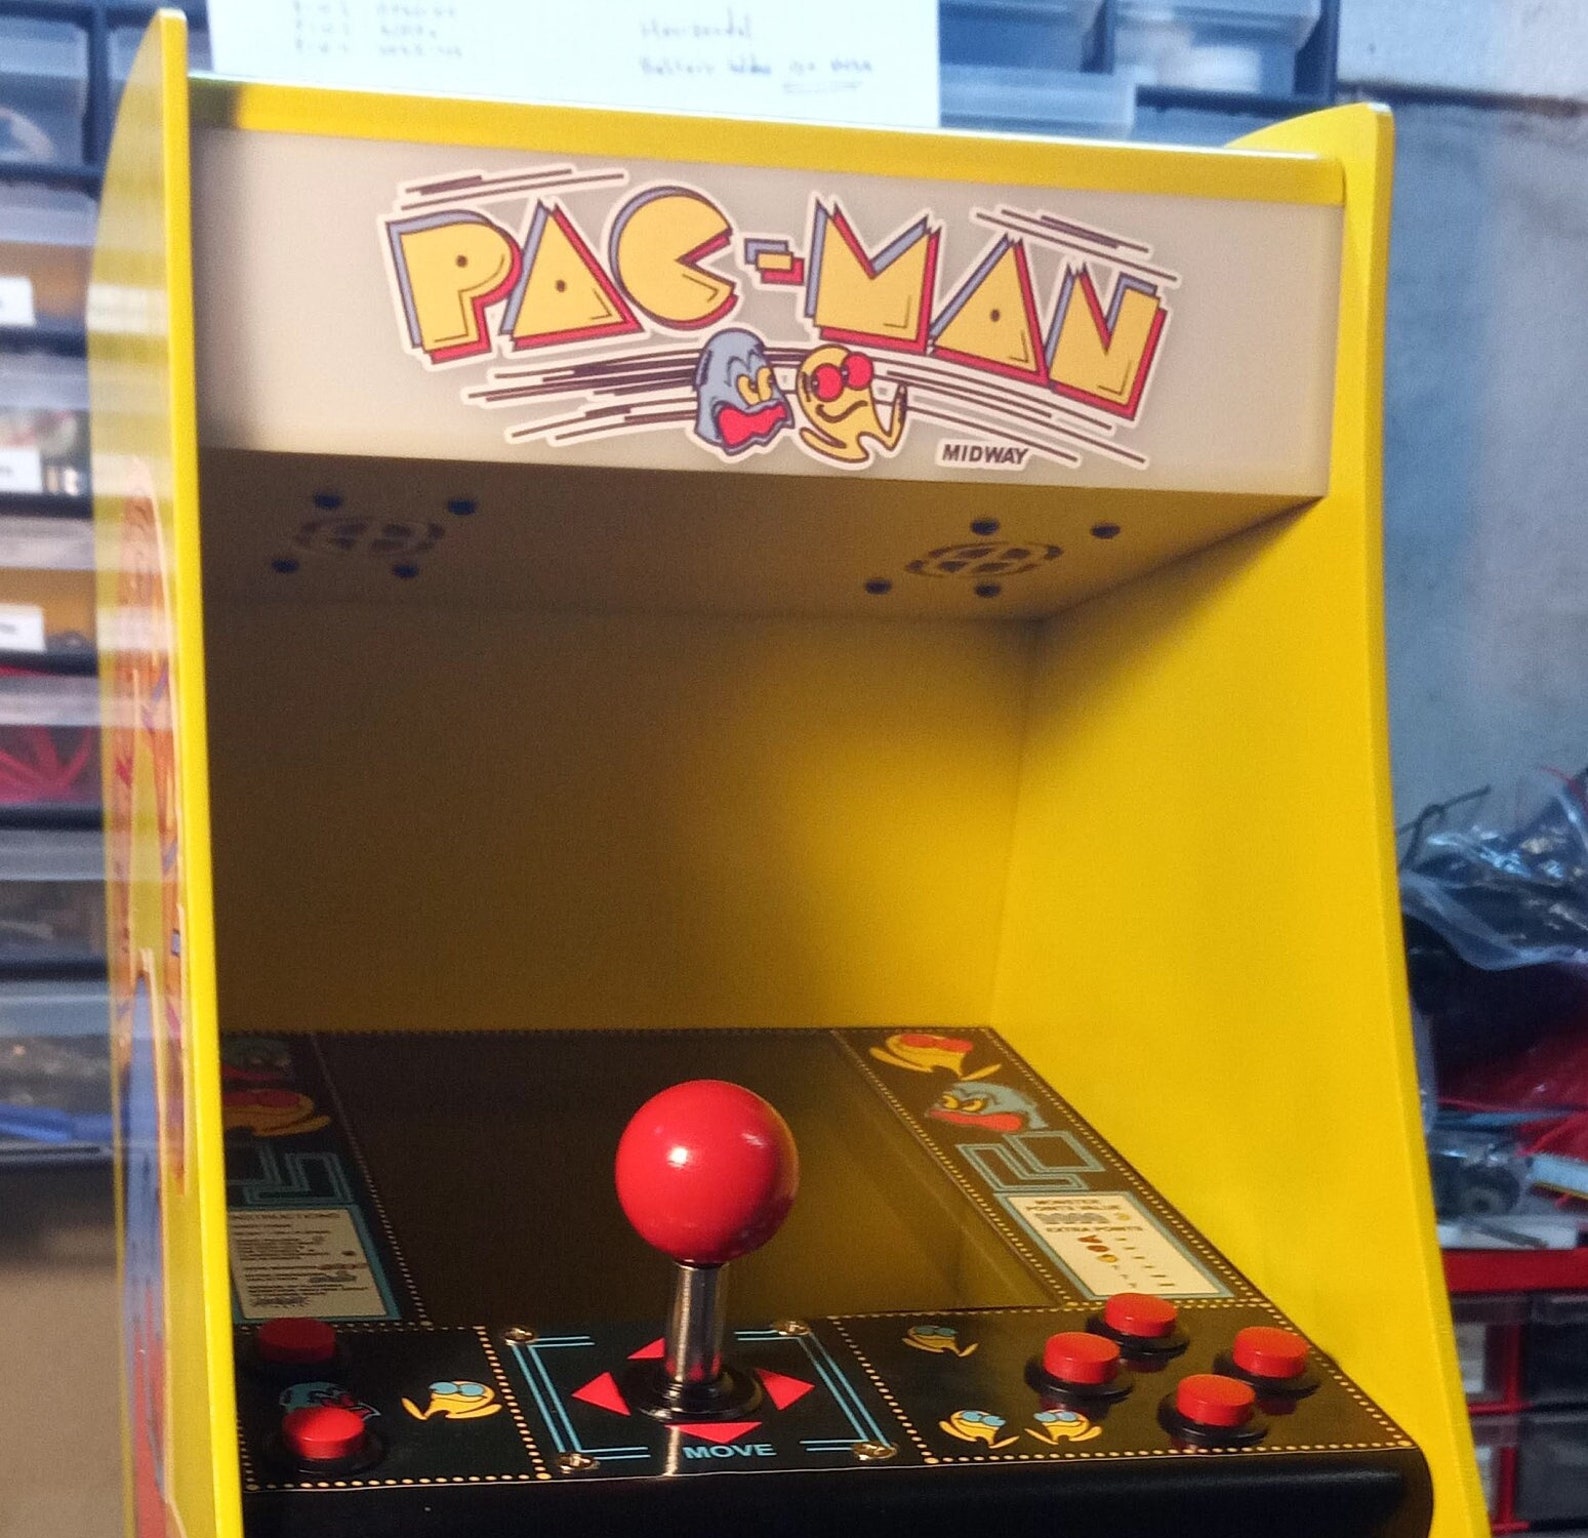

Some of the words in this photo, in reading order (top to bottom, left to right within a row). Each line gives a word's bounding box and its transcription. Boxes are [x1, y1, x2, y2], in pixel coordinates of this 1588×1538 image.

[386, 185, 1167, 420] PAC-MAN
[942, 443, 1029, 465] MIDWAY
[682, 1443, 777, 1459] MOVE
